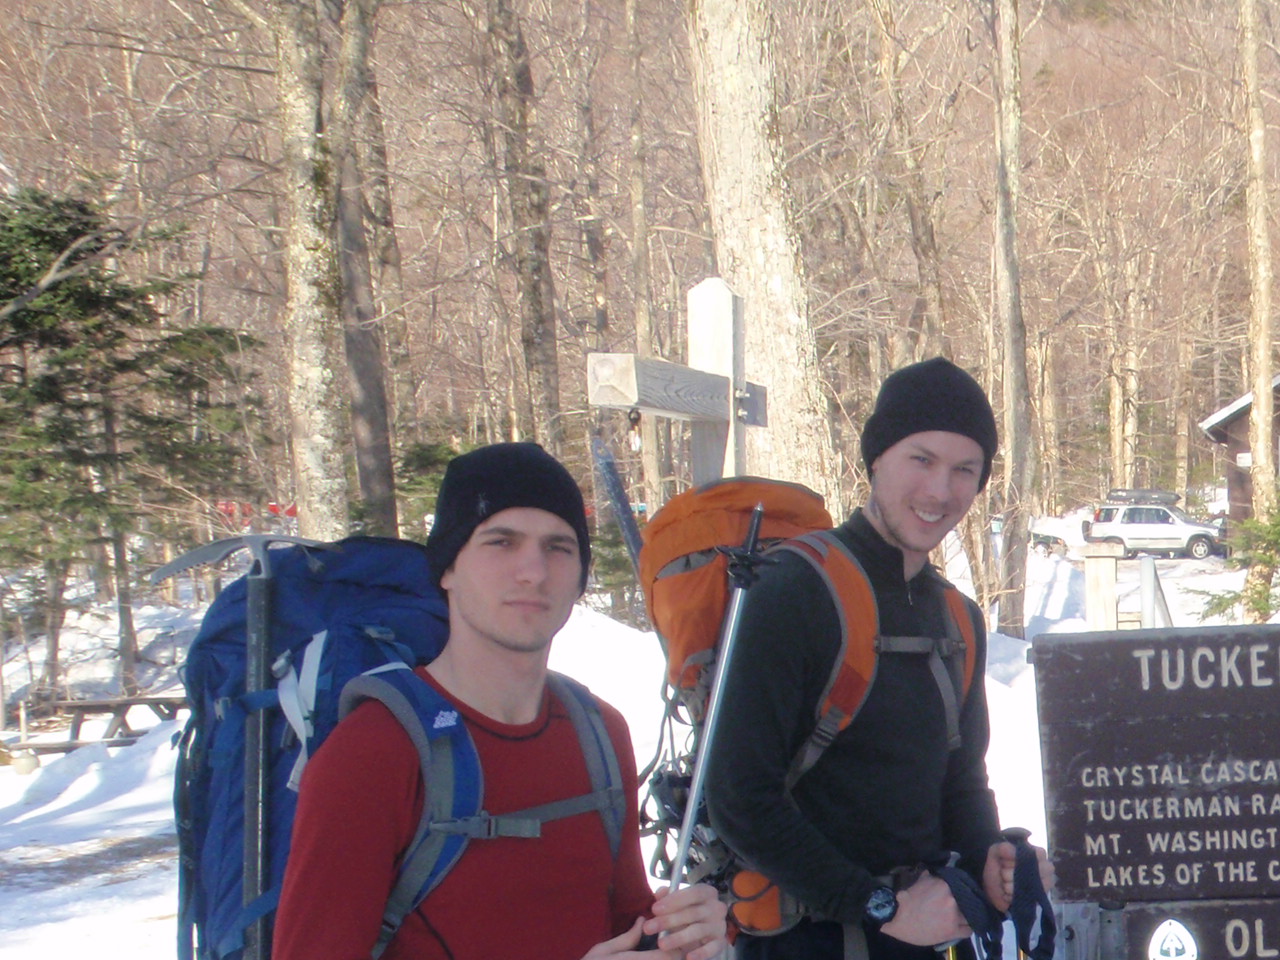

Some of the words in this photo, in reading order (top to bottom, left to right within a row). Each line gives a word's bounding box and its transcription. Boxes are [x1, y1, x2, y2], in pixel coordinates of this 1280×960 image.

[1081, 764, 1190, 788] CRYSTAL
[1083, 795, 1240, 822] TUCKERMAN
[1084, 832, 1132, 856] MT.
[1087, 863, 1166, 888] LAKES
[1174, 862, 1203, 885] OF
[1213, 861, 1259, 883] THE
